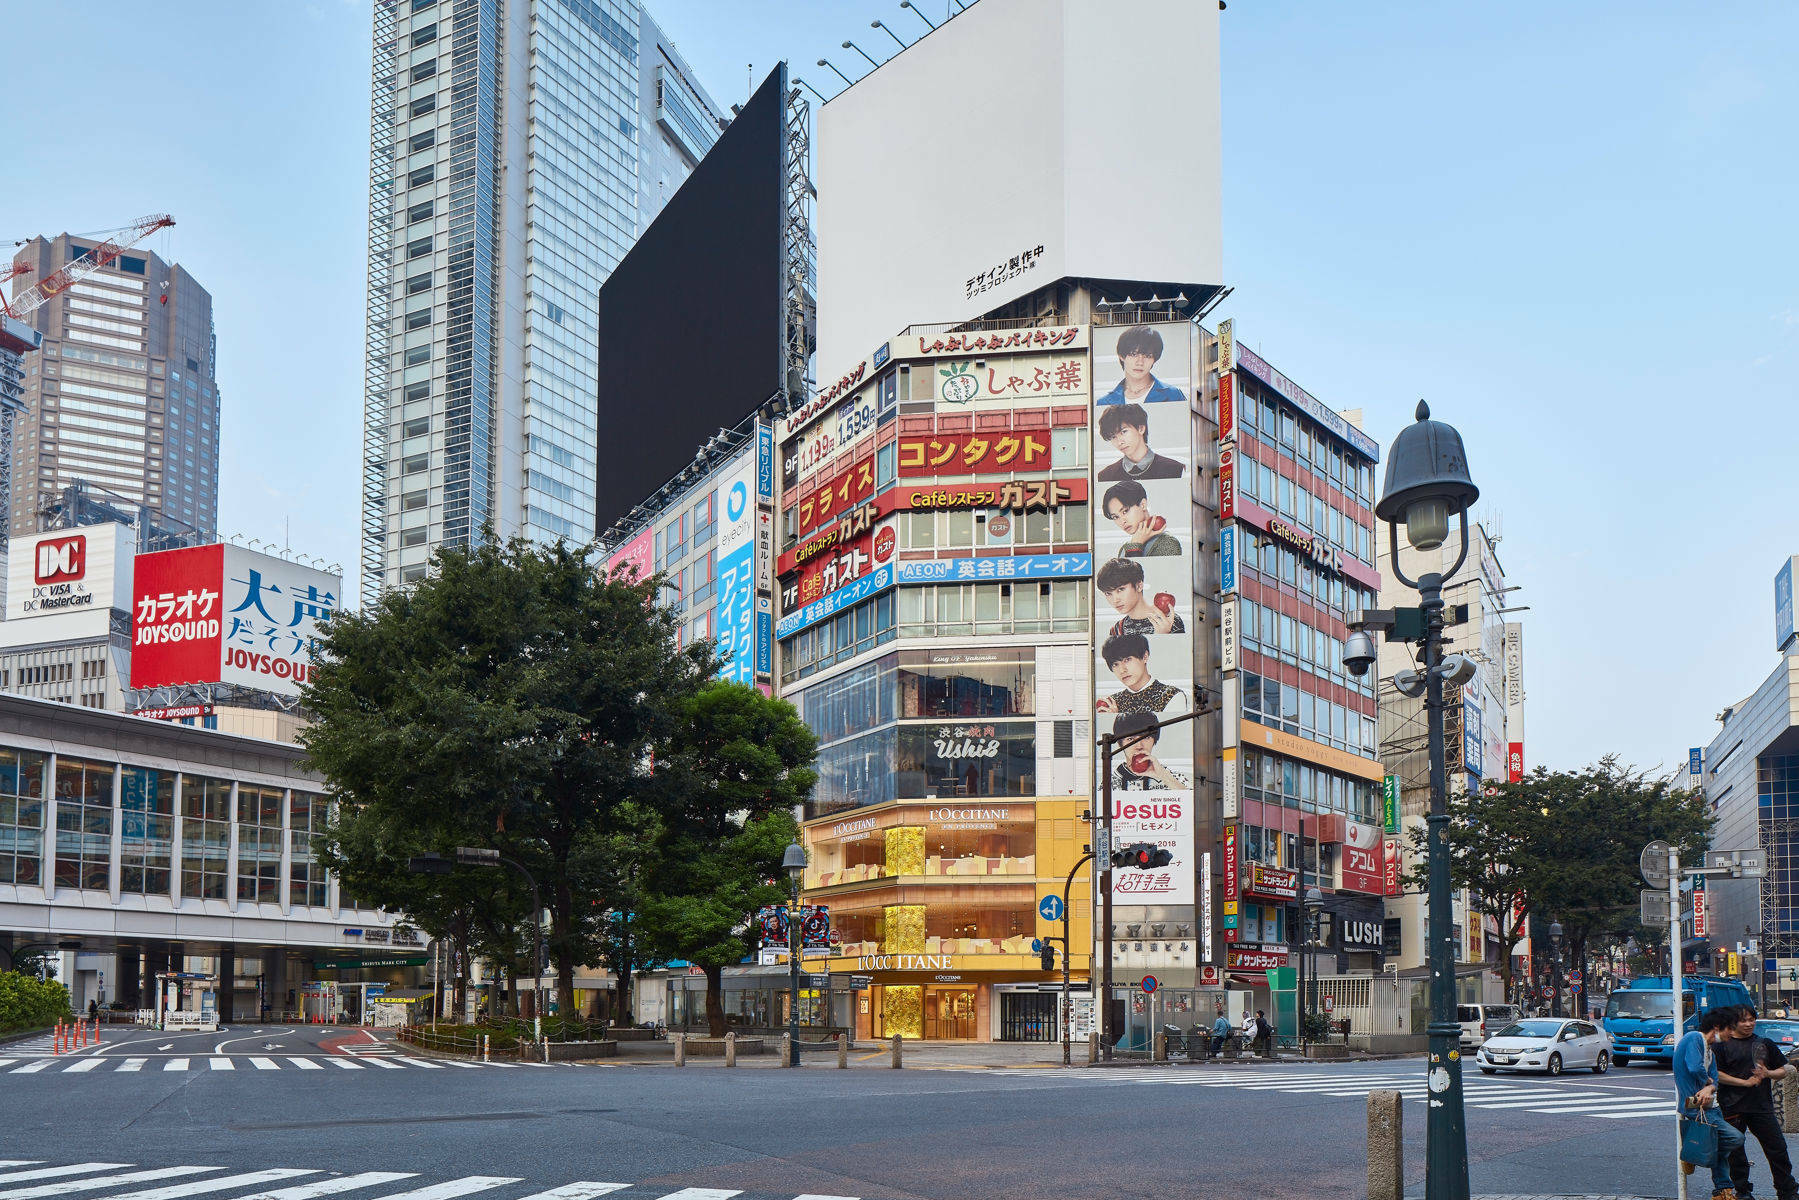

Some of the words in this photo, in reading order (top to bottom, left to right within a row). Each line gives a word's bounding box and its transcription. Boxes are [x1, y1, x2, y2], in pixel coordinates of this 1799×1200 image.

[966, 245, 1044, 292] デザイン製作中
[919, 327, 1080, 353] しゃぶしゃぶバイキング
[988, 361, 1082, 395] しゃぶ葉
[786, 361, 867, 433] しゃぶしゃぶバイキング
[761, 437, 769, 492] 東急リバブル
[785, 454, 798, 476] 9F
[901, 435, 1050, 467] コンタクト
[801, 460, 874, 528] プライス
[911, 490, 996, 509] Caféレストラン
[1000, 480, 1072, 511] ガスト
[1222, 478, 1232, 512] ガスト
[795, 530, 838, 563] Caféレストラン
[839, 503, 878, 543] ガスト
[877, 540, 895, 555] ガスト
[38, 541, 79, 578] DC
[760, 531, 769, 579] 献血ルーム
[903, 561, 949, 579] AEON
[957, 556, 1089, 579] 英会話イーオン
[822, 548, 869, 597] ガスト
[24, 600, 38, 611] DC
[40, 593, 91, 609] MasterCard
[33, 588, 47, 598] DC
[50, 583, 72, 596] VISA
[229, 568, 336, 627] 大声
[783, 584, 798, 608] 7F
[137, 588, 219, 624] カラオケ
[739, 557, 751, 683] コンタクト
[778, 613, 801, 636] AEON
[805, 580, 872, 624] 英会話イーオン
[136, 619, 219, 646] JOYSOUND
[1224, 608, 1233, 665] 渋谷駅前ビル
[1508, 654, 1519, 706] CAMERA
[166, 706, 200, 717] JOYSOUND
[1511, 752, 1521, 772] 免税
[929, 808, 1009, 821] L'OCCITANE
[1111, 800, 1182, 819] Jesus
[833, 817, 877, 836] L'OCCITANE
[1157, 840, 1177, 848] 2018
[1225, 846, 1234, 896] サンドラッグ
[1349, 849, 1376, 872] アコム
[1386, 863, 1395, 886] アコム
[1263, 875, 1289, 887] サンドラッグ
[1694, 894, 1705, 934] HOOTERS
[1120, 942, 1188, 952] 谷駅前ビル
[1344, 920, 1383, 946] LUSH
[1243, 954, 1279, 968] サンドラッグ
